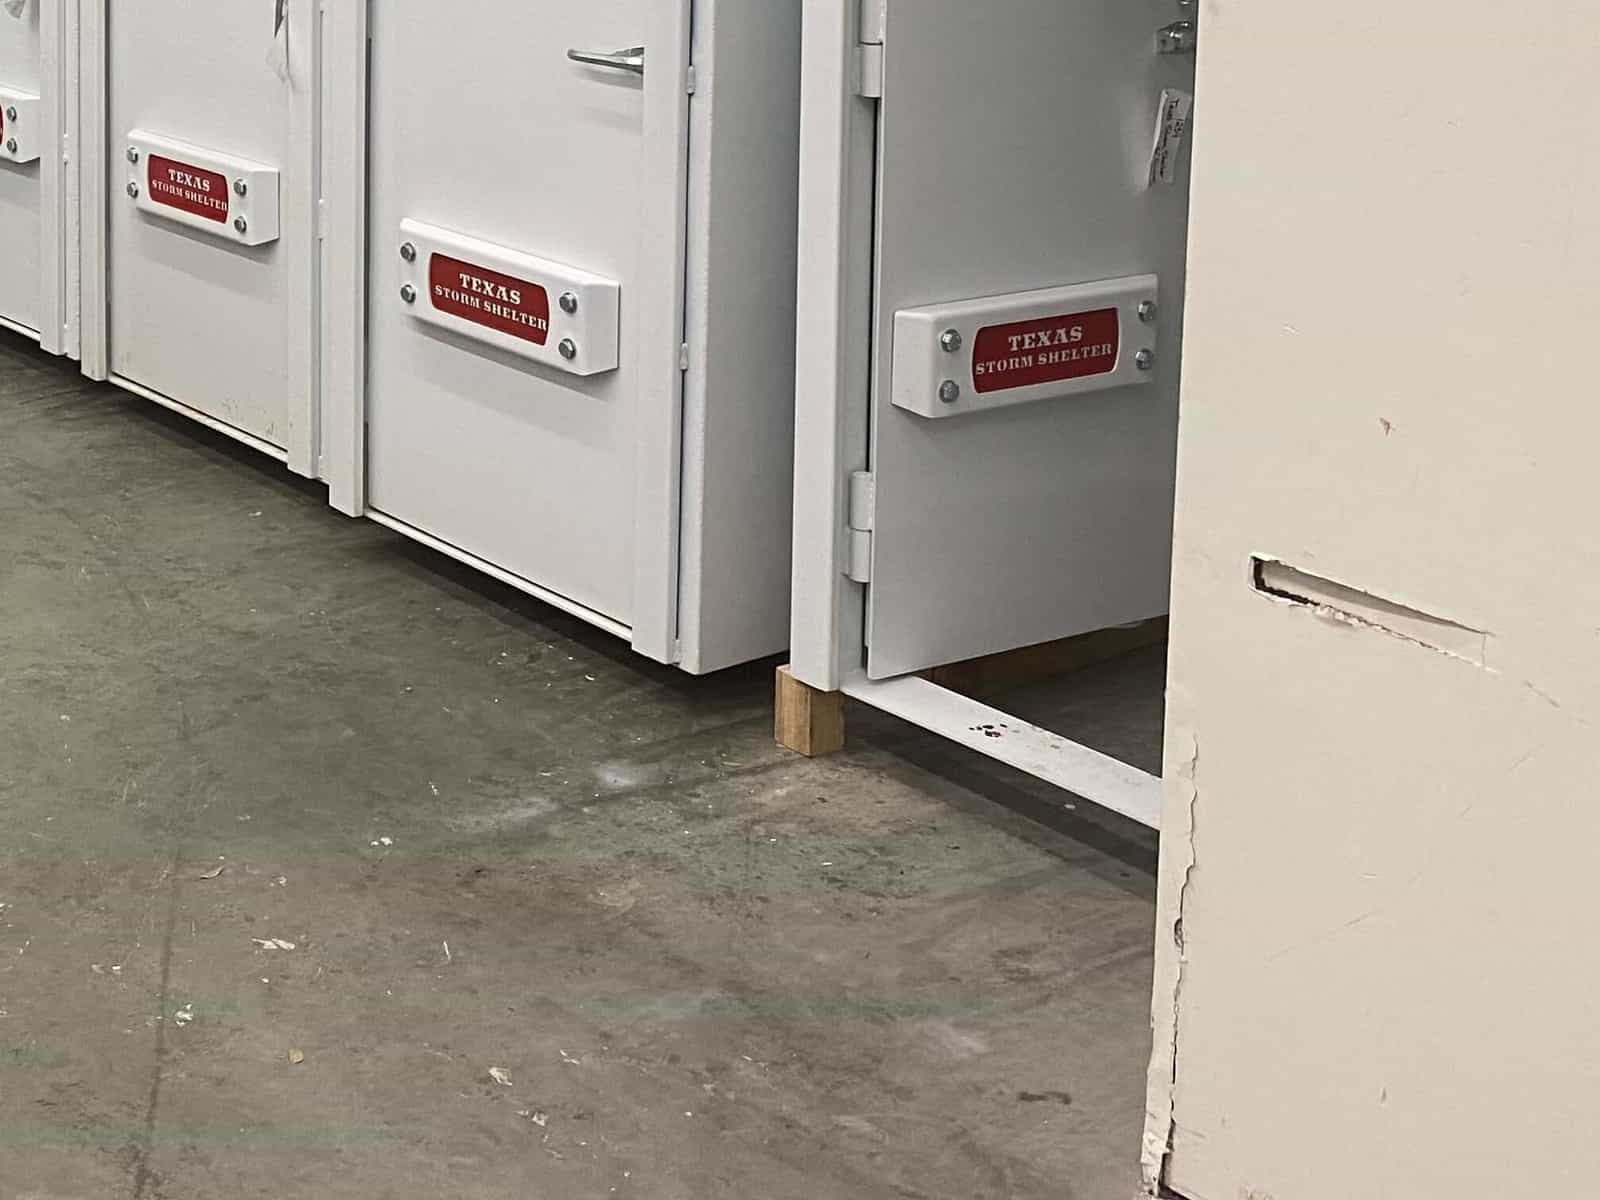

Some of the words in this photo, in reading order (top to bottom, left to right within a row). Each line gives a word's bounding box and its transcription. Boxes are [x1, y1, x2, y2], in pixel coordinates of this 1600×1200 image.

[152, 179, 183, 197] STORM
[167, 168, 210, 192] TEXAS
[459, 273, 521, 305] TEXAS
[434, 285, 481, 309] STORM
[483, 301, 547, 332] SHELTER
[1008, 325, 1083, 351] TEXAS
[975, 356, 1034, 375] STORM
[1038, 343, 1113, 366] SHELTER
